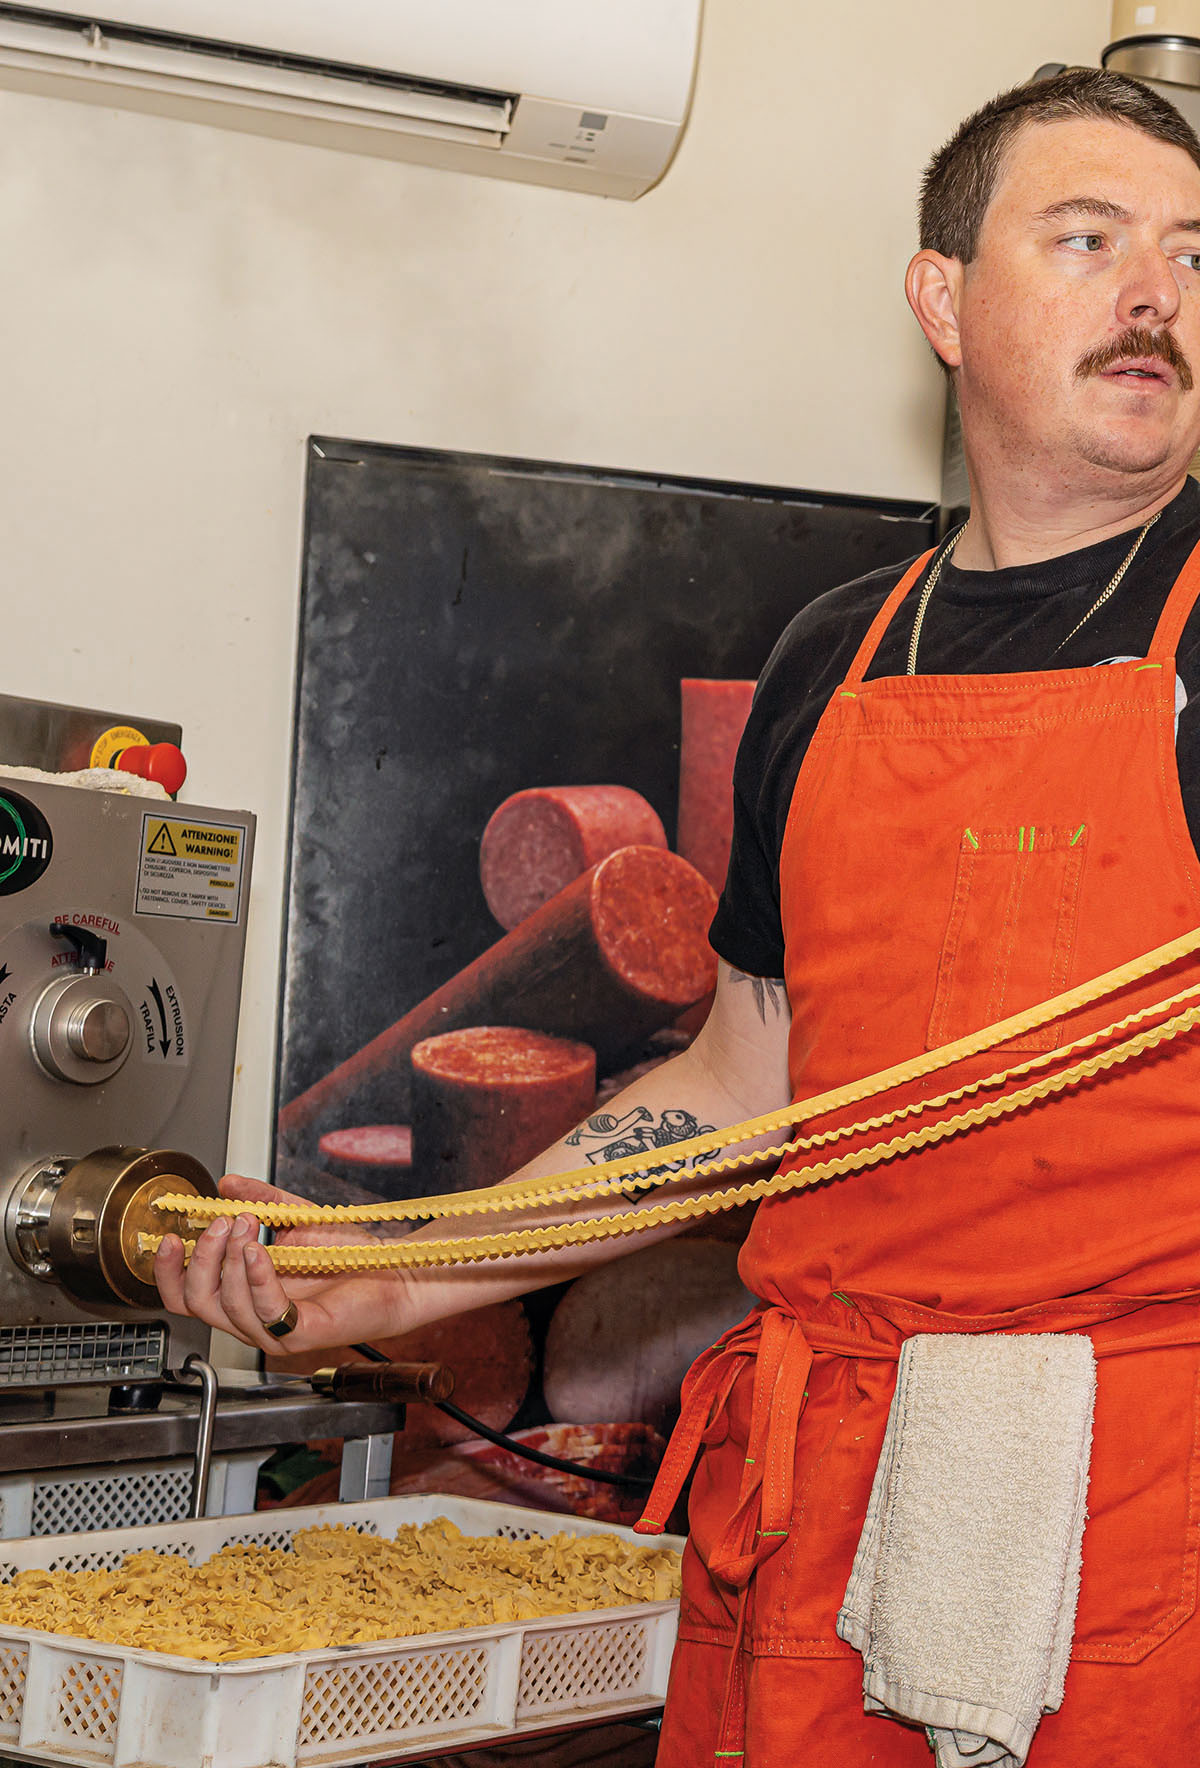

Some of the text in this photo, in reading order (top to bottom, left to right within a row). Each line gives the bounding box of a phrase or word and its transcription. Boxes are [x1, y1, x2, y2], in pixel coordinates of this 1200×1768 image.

[0, 834, 48, 859] MITI
[181, 829, 238, 845] ATTENZIONE!
[185, 843, 234, 858] WARNING!
[54, 913, 120, 935] BE CAREFUL
[140, 1000, 155, 1054] TRAFILA
[165, 985, 184, 1056] EXTRUSION
